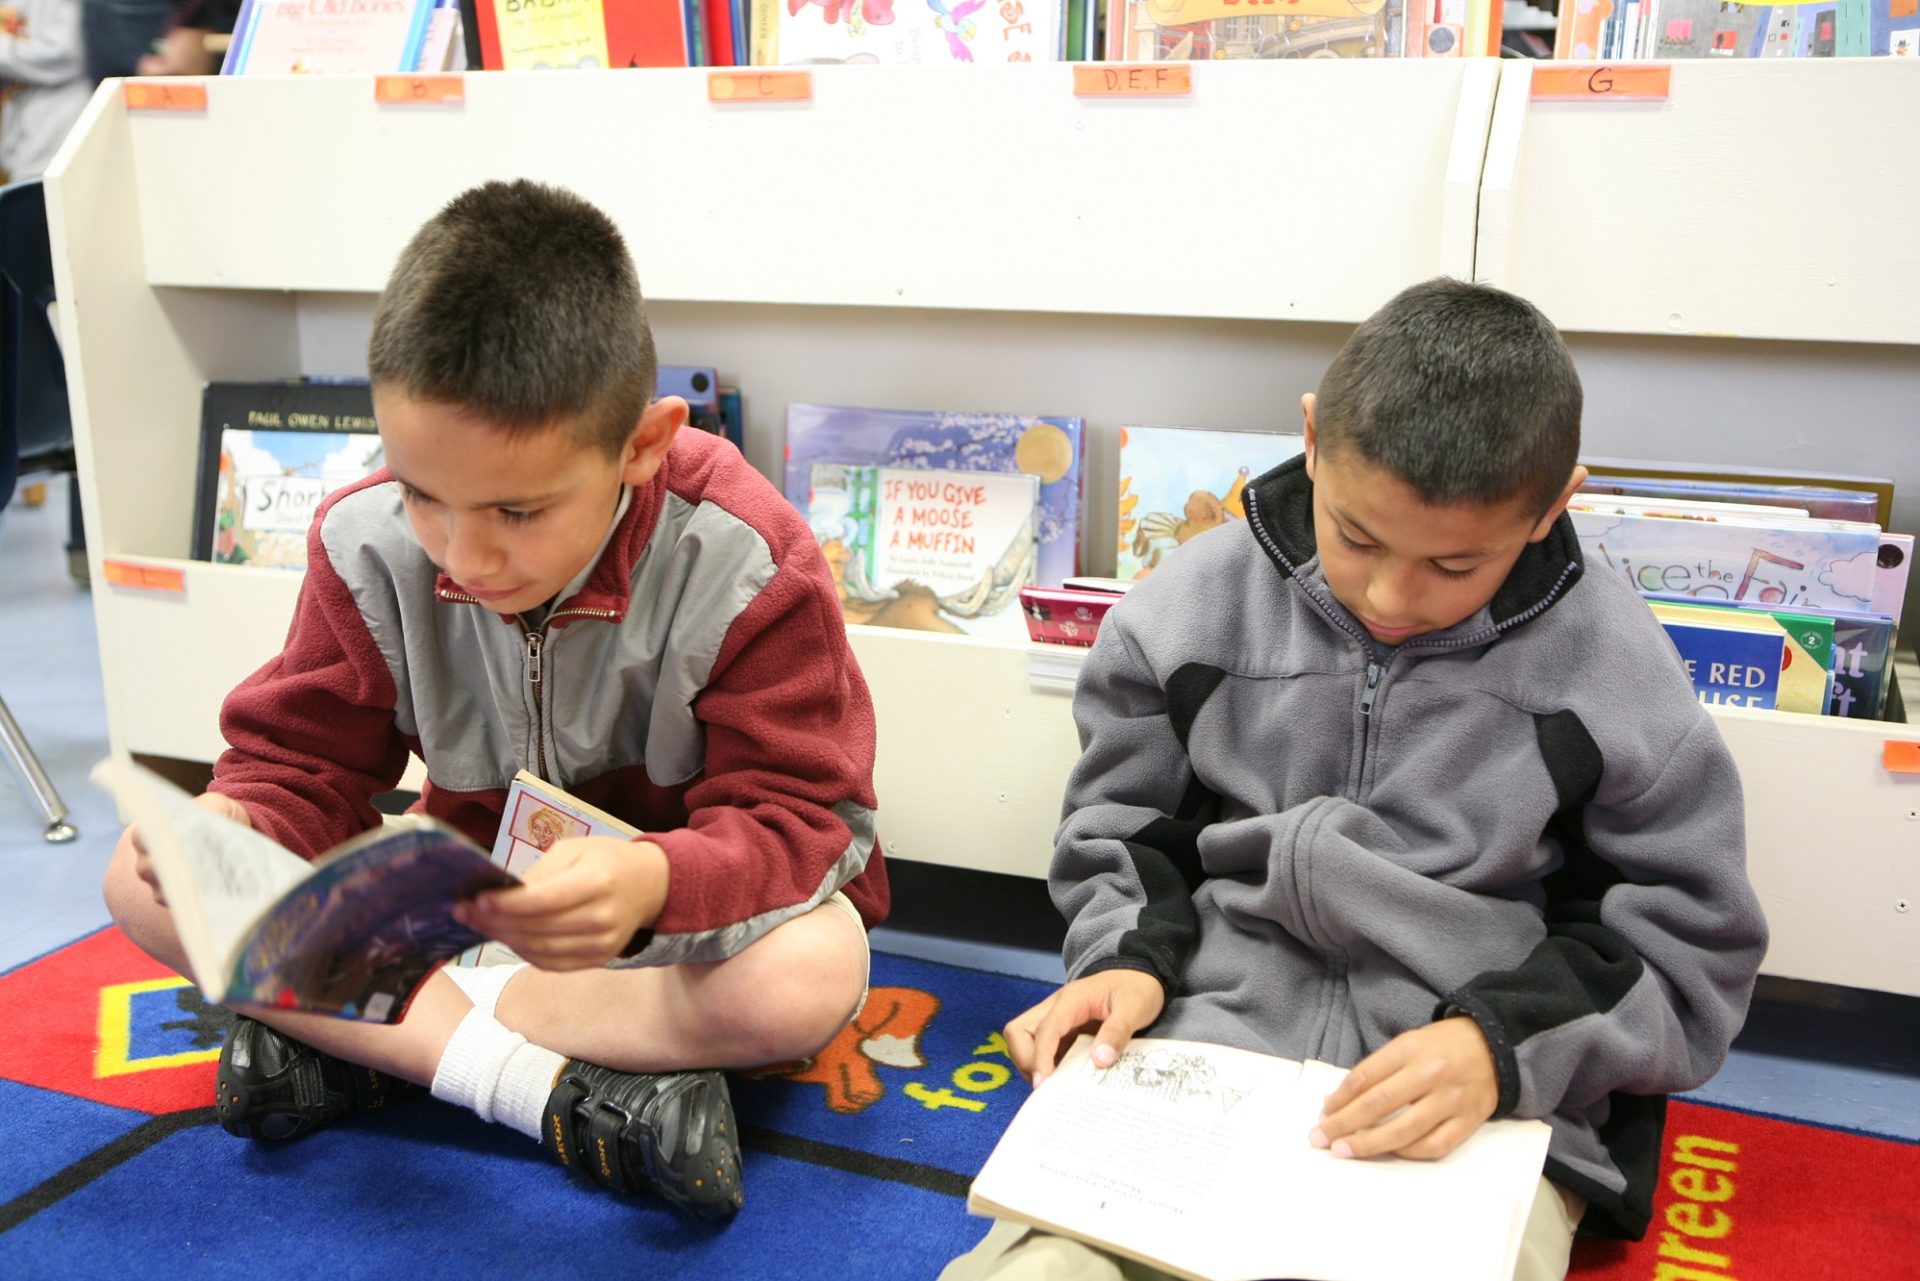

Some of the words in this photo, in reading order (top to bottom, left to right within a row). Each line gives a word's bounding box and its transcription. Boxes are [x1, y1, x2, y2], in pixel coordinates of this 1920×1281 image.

[758, 73, 775, 95] C
[1587, 67, 1614, 94] G
[248, 411, 282, 426] PAUL
[288, 413, 330, 428] OWEN
[885, 480, 903, 501] IF
[907, 481, 940, 501] YOU
[943, 483, 986, 506] GIVE
[894, 506, 904, 525] A
[912, 508, 974, 529] MOOSE
[889, 531, 900, 549] A
[908, 532, 975, 554] MUFFIN
[1598, 542, 1692, 592] lice
[1694, 560, 1734, 584] the
[1807, 636, 1816, 645] 2
[1709, 662, 1766, 689] RED
